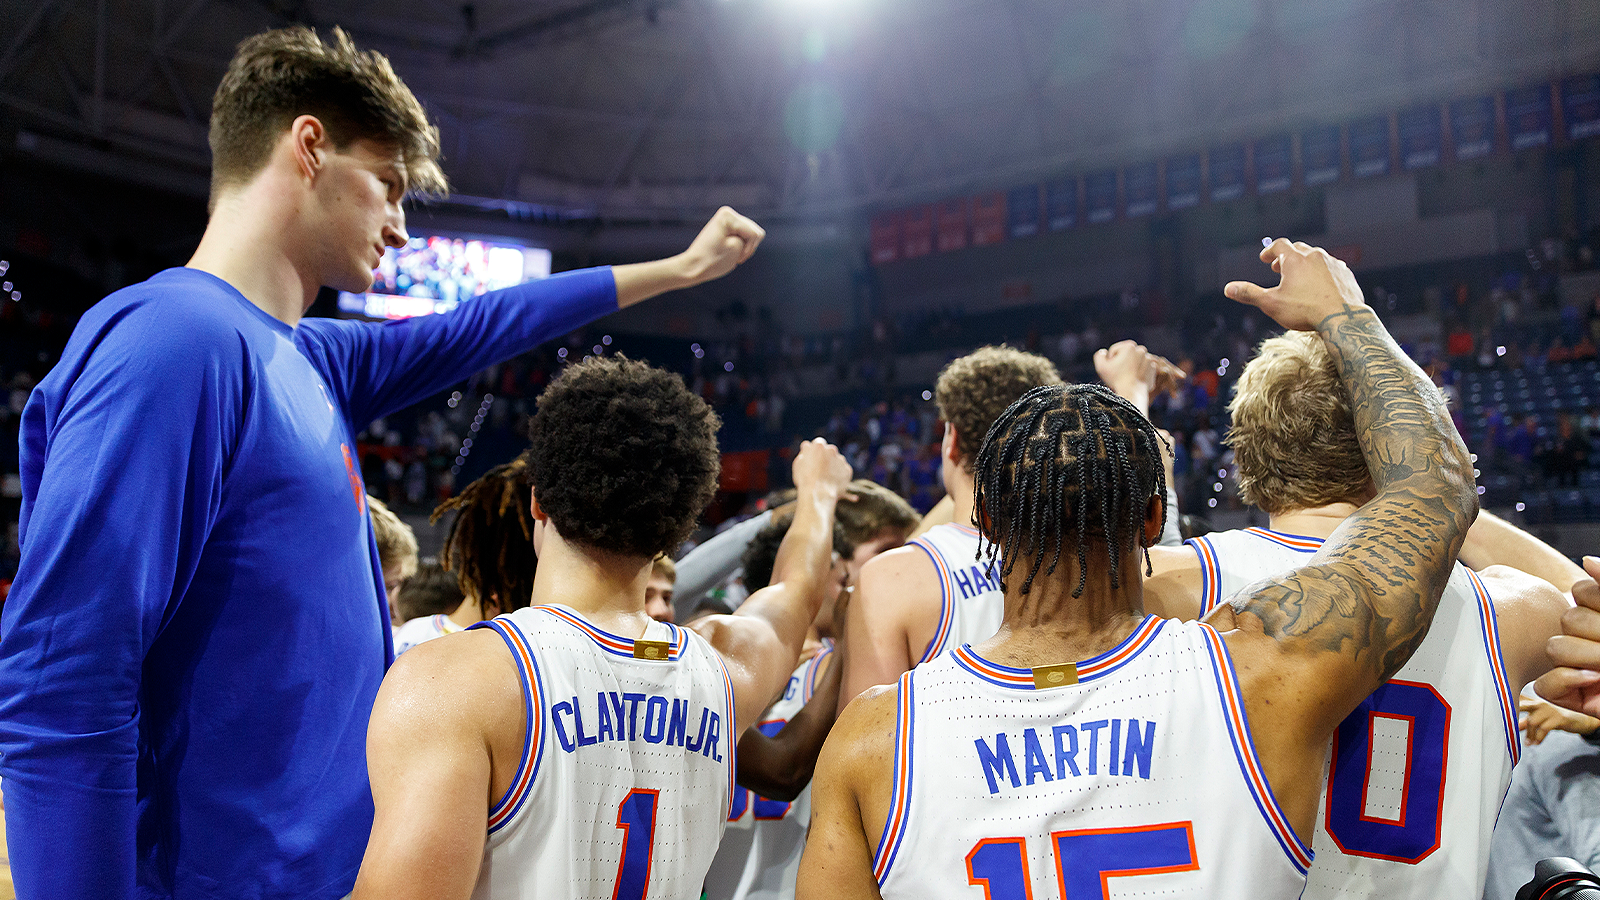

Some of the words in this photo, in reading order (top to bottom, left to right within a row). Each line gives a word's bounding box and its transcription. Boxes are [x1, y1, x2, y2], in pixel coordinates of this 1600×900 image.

[953, 560, 1002, 599] HAN
[551, 691, 688, 754] CLAYTON
[974, 719, 1157, 795] MARTIN
[1325, 678, 1453, 866] 0
[611, 787, 660, 900] 1
